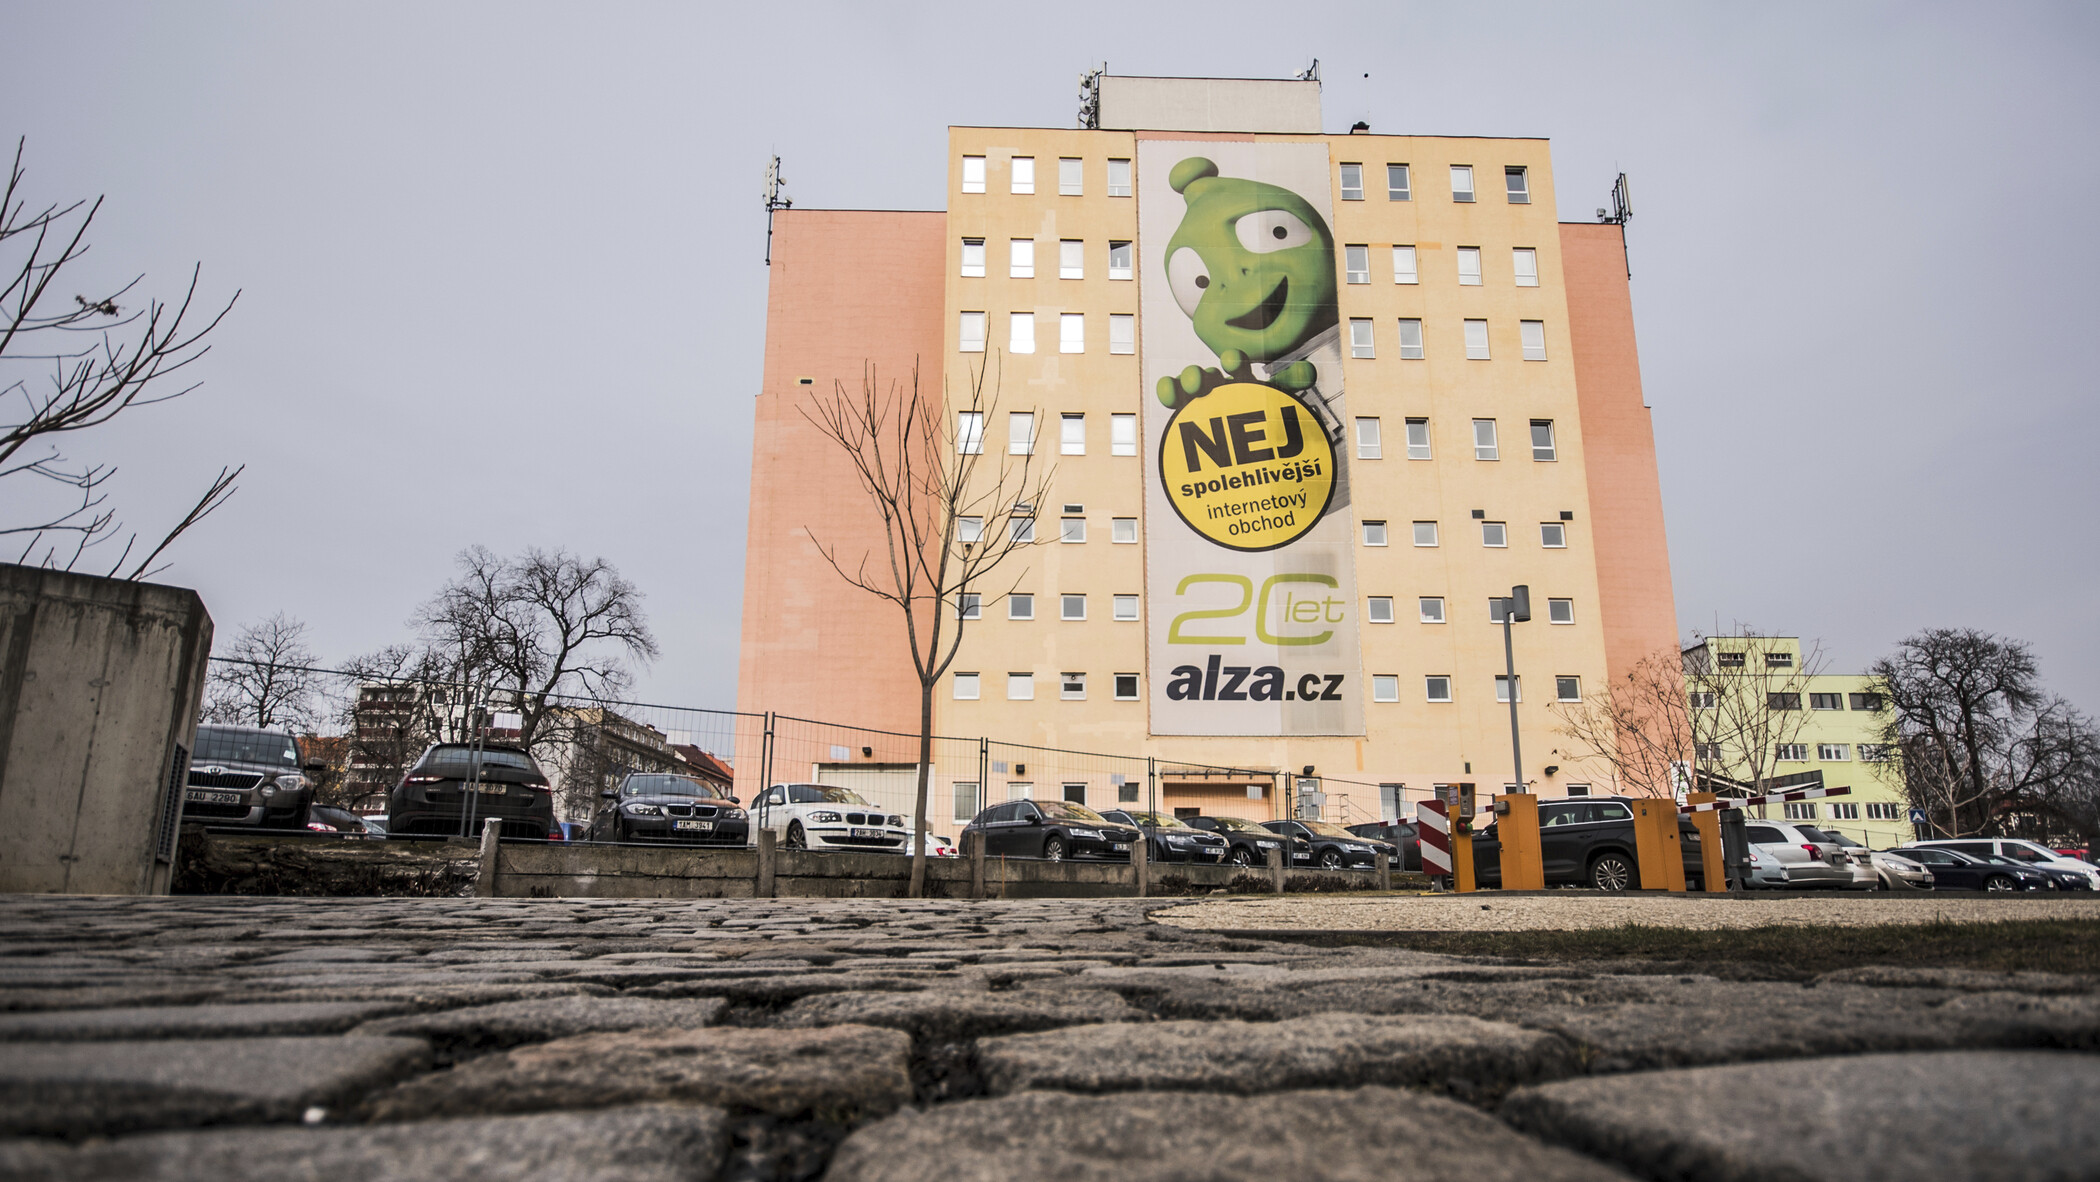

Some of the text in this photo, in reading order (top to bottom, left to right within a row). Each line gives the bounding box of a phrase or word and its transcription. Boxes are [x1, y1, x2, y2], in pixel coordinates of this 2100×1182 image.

[1179, 405, 1304, 473] NEJ
[1181, 458, 1322, 497] spolehlivější
[1207, 489, 1307, 520] internetový
[1228, 510, 1295, 536] obchod
[1284, 591, 1345, 623] let
[1166, 654, 1344, 701] alza.cz
[212, 793, 236, 803] 2290
